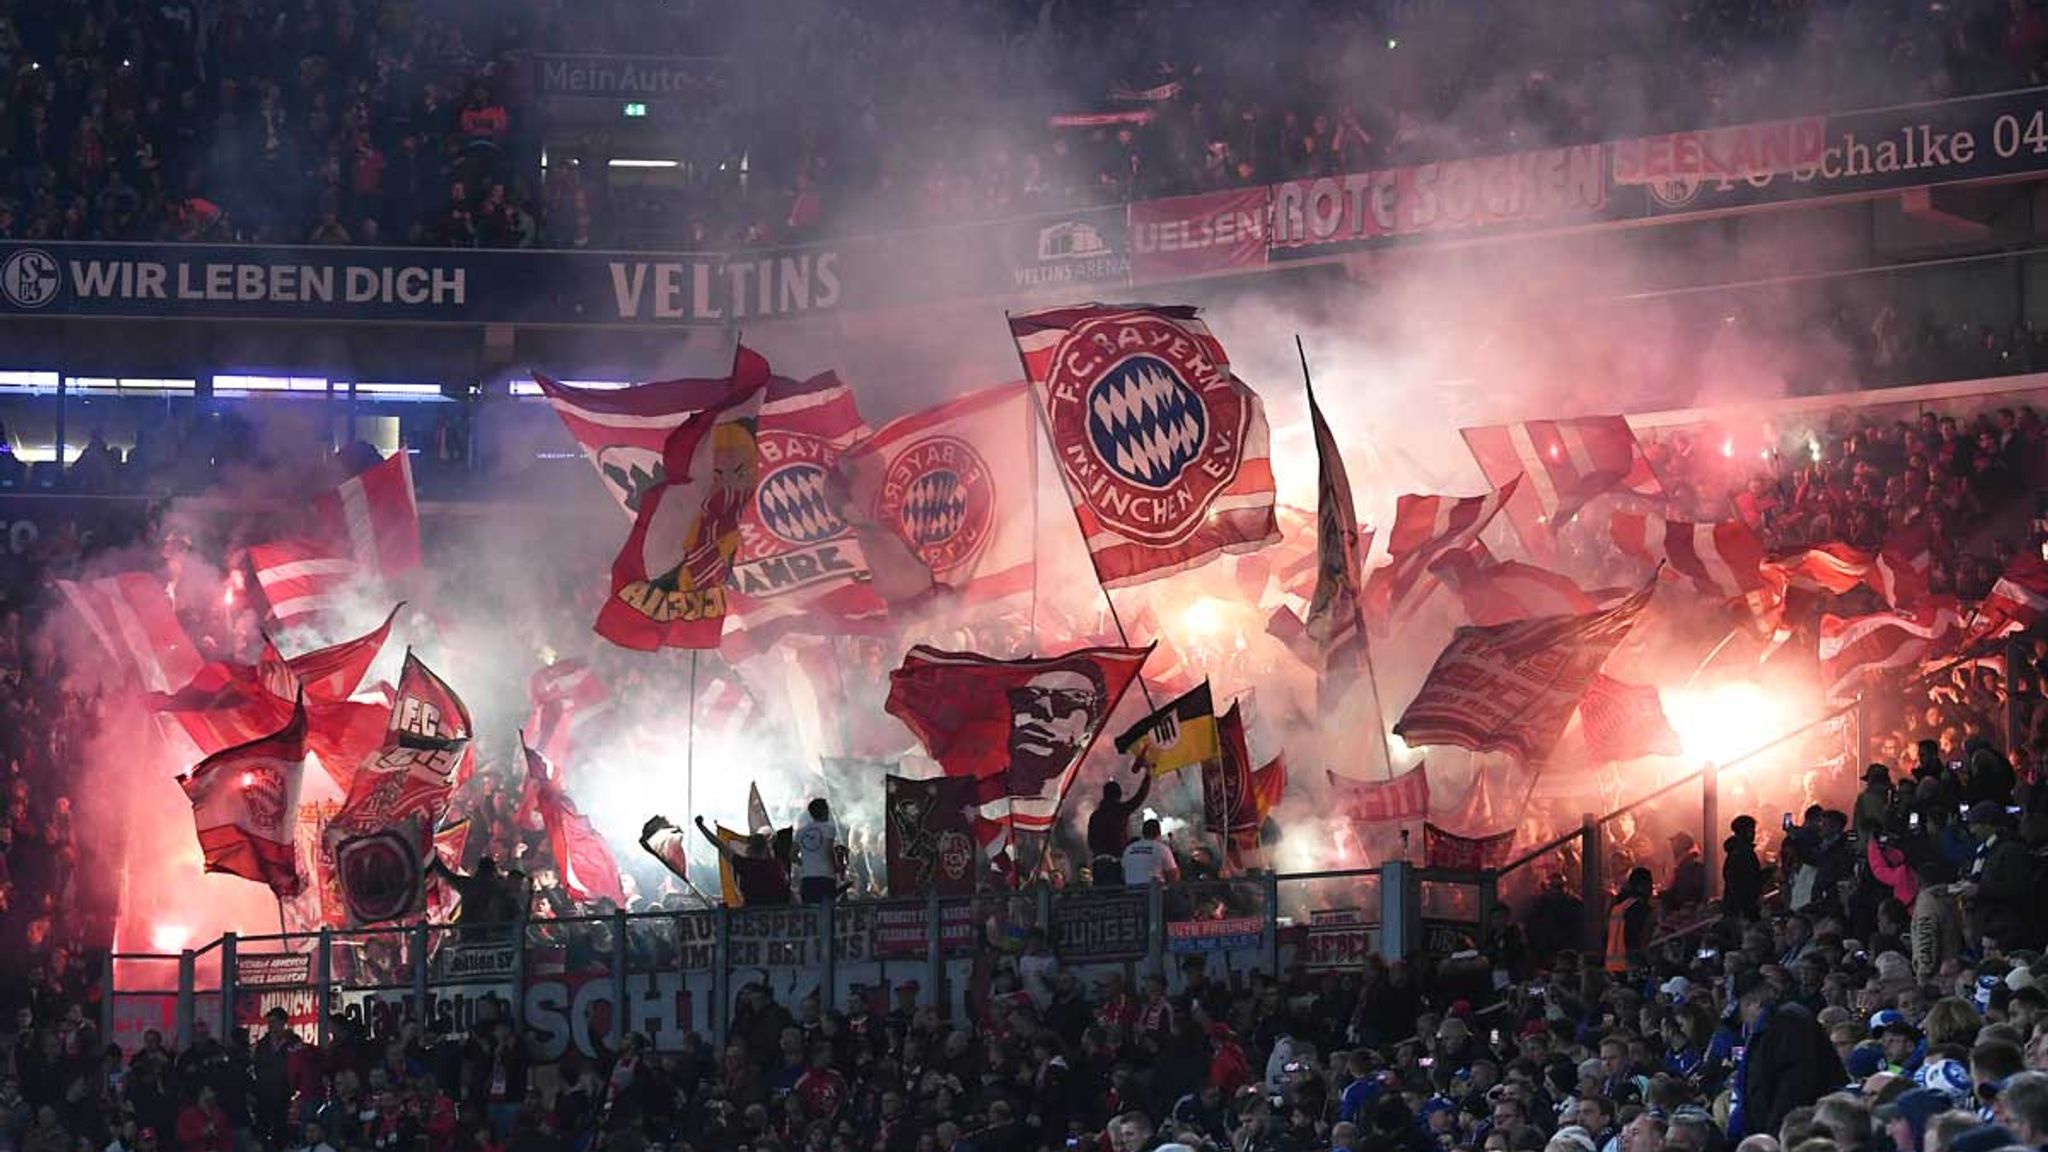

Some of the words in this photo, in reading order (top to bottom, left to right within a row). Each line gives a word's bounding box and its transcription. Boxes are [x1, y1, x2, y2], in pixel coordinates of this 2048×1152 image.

[1993, 110, 2048, 157] 04
[1277, 169, 1398, 242] ROTE
[1135, 209, 1263, 251] UELSEN
[70, 261, 167, 298] WIR
[179, 263, 333, 301] LEBEN
[347, 266, 465, 305] DICH
[609, 251, 841, 318] VELTINS
[1092, 326, 1229, 393] BAYERN
[680, 907, 867, 940] AUGESPERTE
